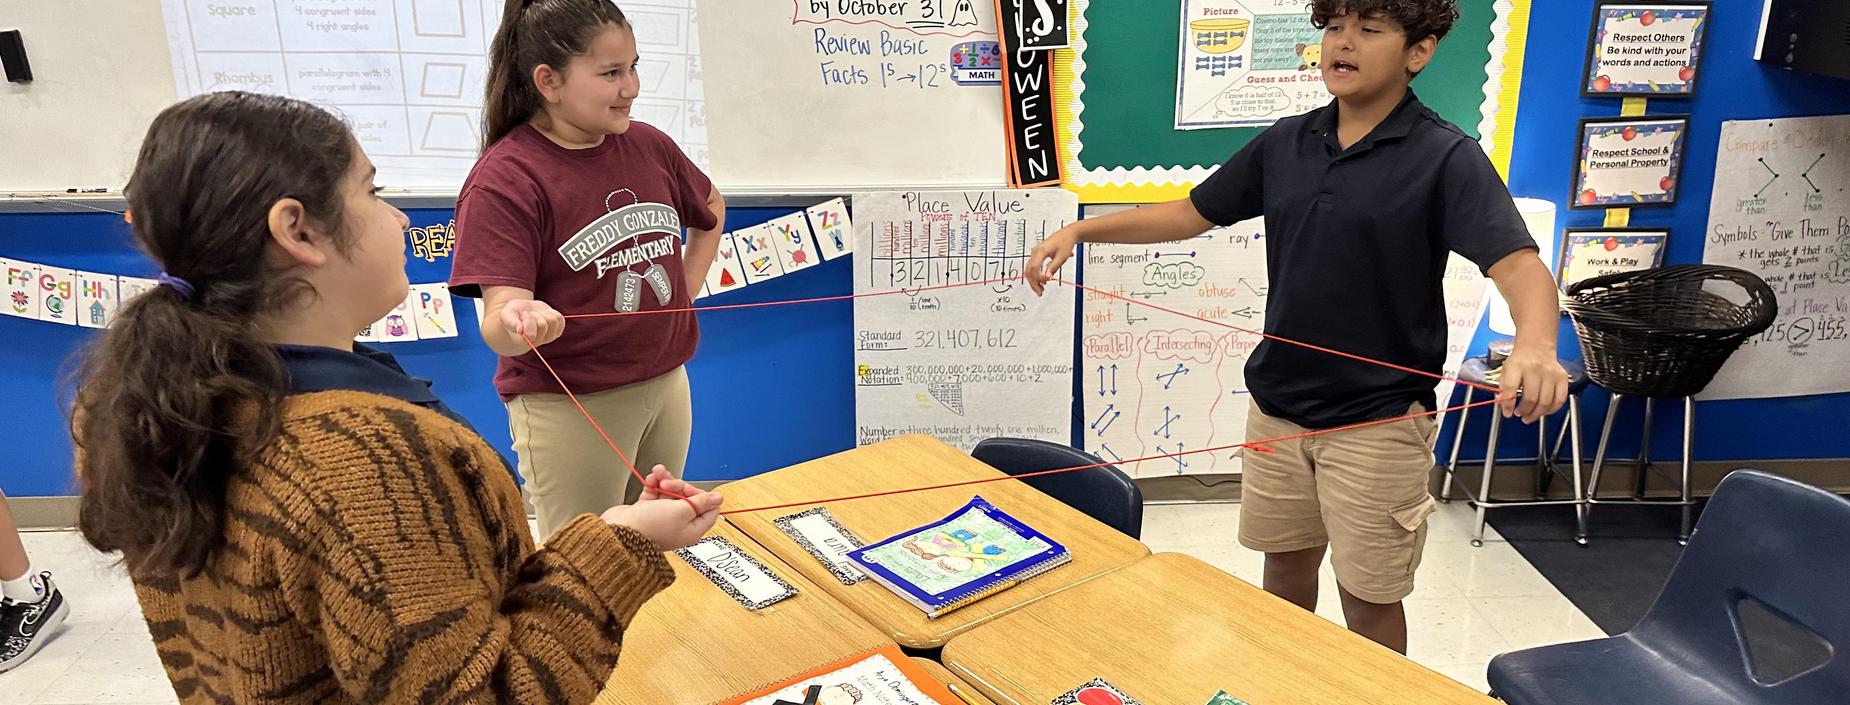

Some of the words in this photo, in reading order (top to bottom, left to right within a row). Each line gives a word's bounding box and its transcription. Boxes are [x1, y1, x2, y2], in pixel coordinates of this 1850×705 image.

[208, 3, 256, 19] Square
[304, 7, 351, 18] congruent
[353, 7, 376, 15] sides
[811, 0, 829, 19] by
[837, 0, 907, 16] October
[920, 0, 943, 18] 31
[1203, 7, 1239, 16] Picture
[315, 21, 338, 32] right
[341, 22, 369, 32] angles
[815, 27, 870, 56] Review
[880, 30, 928, 56] Basic
[1613, 33, 1652, 43] Respect
[1654, 33, 1685, 42] Others
[1607, 46, 1620, 54] Be
[1622, 46, 1642, 54] kind
[1644, 46, 1663, 54] with
[1665, 47, 1687, 56] your
[1633, 58, 1651, 66] and
[1653, 58, 1687, 66] actions
[214, 71, 274, 84] Rhombus
[820, 61, 869, 86] Facts
[968, 71, 995, 80] MATH
[1247, 76, 1275, 84] Guess
[1592, 148, 1629, 158] Respect
[1631, 147, 1660, 156] School
[1590, 160, 1629, 169] Personal
[1631, 158, 1669, 167] Property
[906, 191, 949, 213] Place
[963, 190, 1024, 214] Value
[817, 210, 841, 229] Zz
[974, 211, 996, 221] TEN
[778, 224, 801, 244] Yy
[1711, 224, 1758, 246] Symbols
[1800, 218, 1829, 239] Them
[567, 219, 622, 268] FREDDY
[742, 235, 768, 253] Xx
[1229, 235, 1249, 248] ray
[594, 235, 675, 280] ELEMENTARY
[1088, 252, 1105, 265] line
[1110, 250, 1151, 268] segment
[1749, 248, 1764, 259] the
[1768, 247, 1790, 258] whole
[1802, 245, 1821, 256] that
[1587, 258, 1610, 266] Work
[1620, 257, 1640, 267] Play
[1760, 257, 1780, 270] gets
[1795, 256, 1819, 268] points
[895, 261, 906, 282] 3
[914, 260, 925, 280] 2
[950, 260, 960, 282] 4
[971, 262, 981, 280] 0
[989, 261, 1000, 281] 7
[1008, 260, 1019, 282] 6
[1152, 266, 1197, 285] Angles
[1798, 271, 1817, 281] that
[651, 271, 668, 296] SEMPER
[1794, 281, 1815, 292] point
[623, 279, 636, 312] 2142473
[1087, 287, 1126, 304] straight
[1199, 283, 1236, 297] obtuse
[1804, 297, 1829, 314] Place
[1085, 311, 1113, 327] right
[1196, 307, 1229, 319] acute
[859, 330, 902, 342] Standard
[1089, 336, 1130, 353] Parallel
[1153, 334, 1216, 357] Intersecting
[858, 365, 899, 377] Expanded
[860, 374, 904, 385] Notation:
[860, 425, 897, 436] Number
[934, 424, 971, 434] hundred
[975, 424, 1004, 436] twenty
